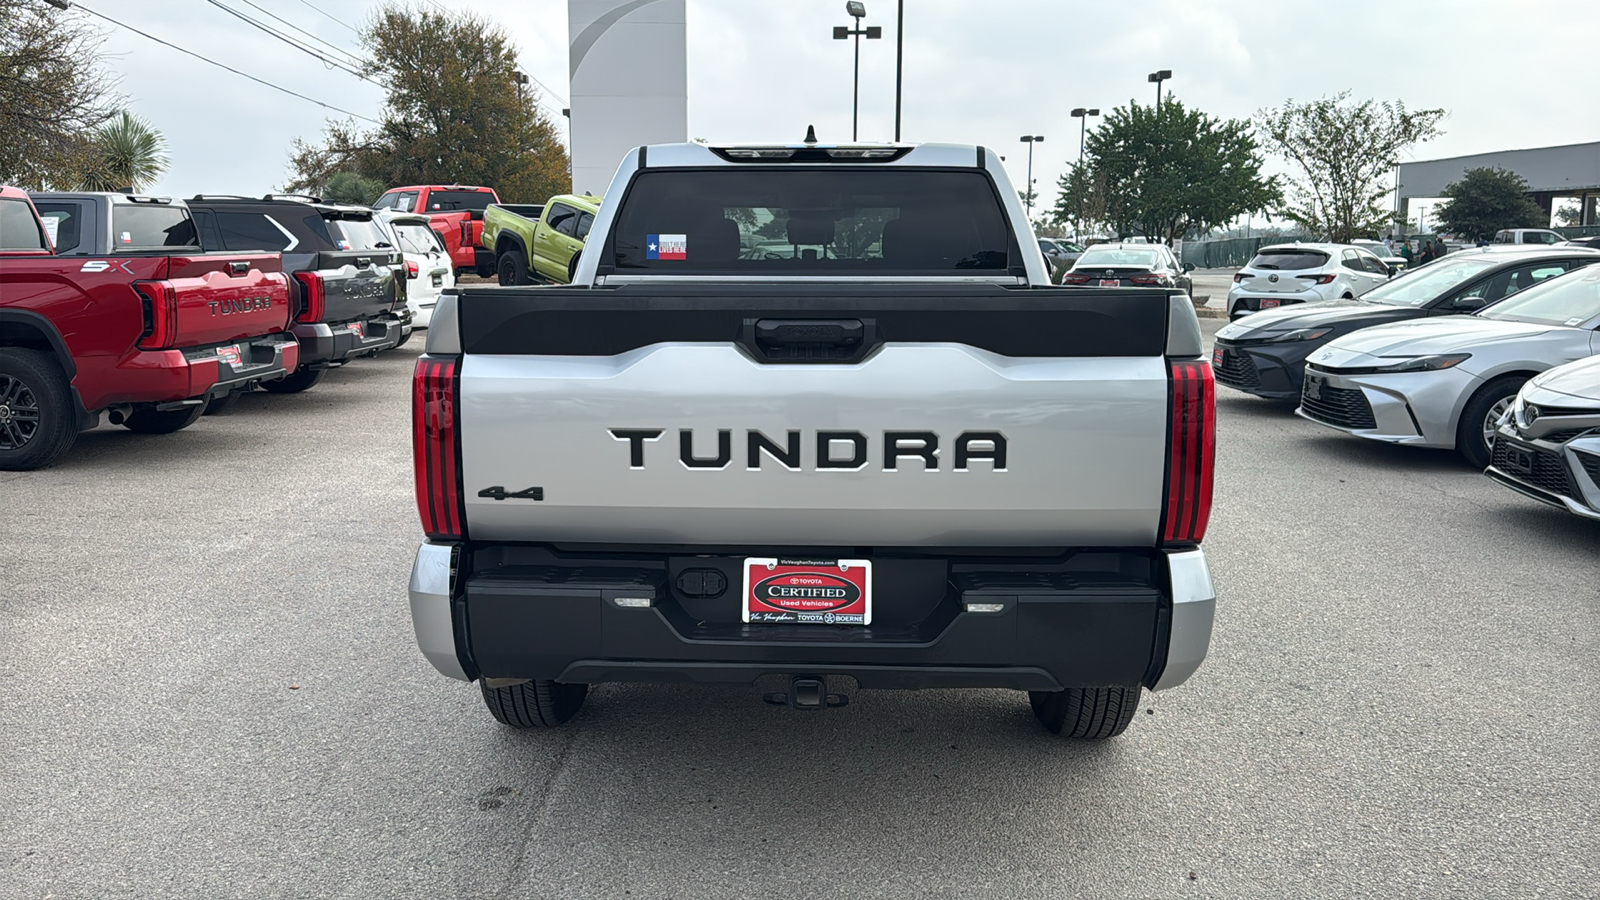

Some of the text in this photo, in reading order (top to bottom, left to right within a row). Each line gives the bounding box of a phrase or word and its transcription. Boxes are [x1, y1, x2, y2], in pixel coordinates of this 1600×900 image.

[207, 295, 272, 317] TUNDRA
[786, 326, 834, 338] TOYOTA
[606, 428, 1009, 472] TUNDRA
[767, 585, 846, 598] CERTIFIED
[750, 612, 796, 622] Vic Vaughan
